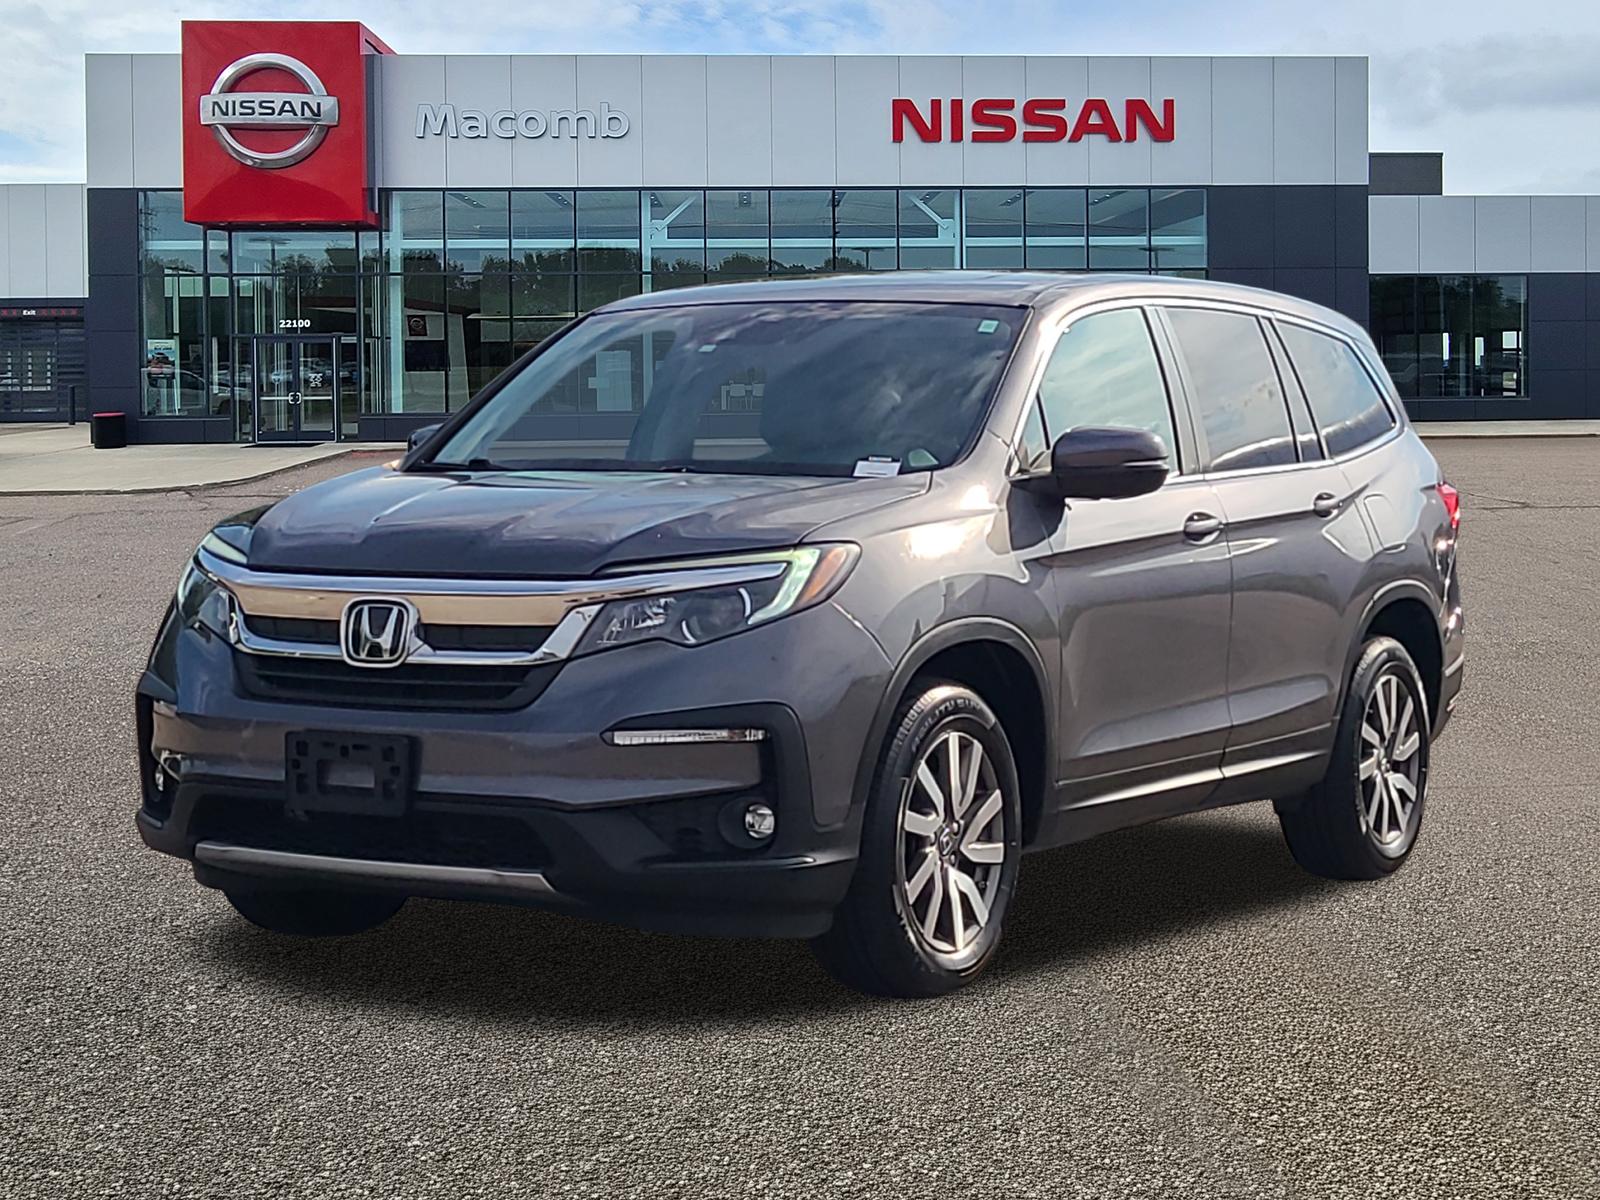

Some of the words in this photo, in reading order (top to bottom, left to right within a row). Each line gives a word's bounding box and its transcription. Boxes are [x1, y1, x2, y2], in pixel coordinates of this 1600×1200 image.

[212, 100, 322, 118] NISSAN
[415, 102, 630, 139] Macomb
[892, 98, 1175, 143] NISSAN
[279, 319, 311, 328] 22100
